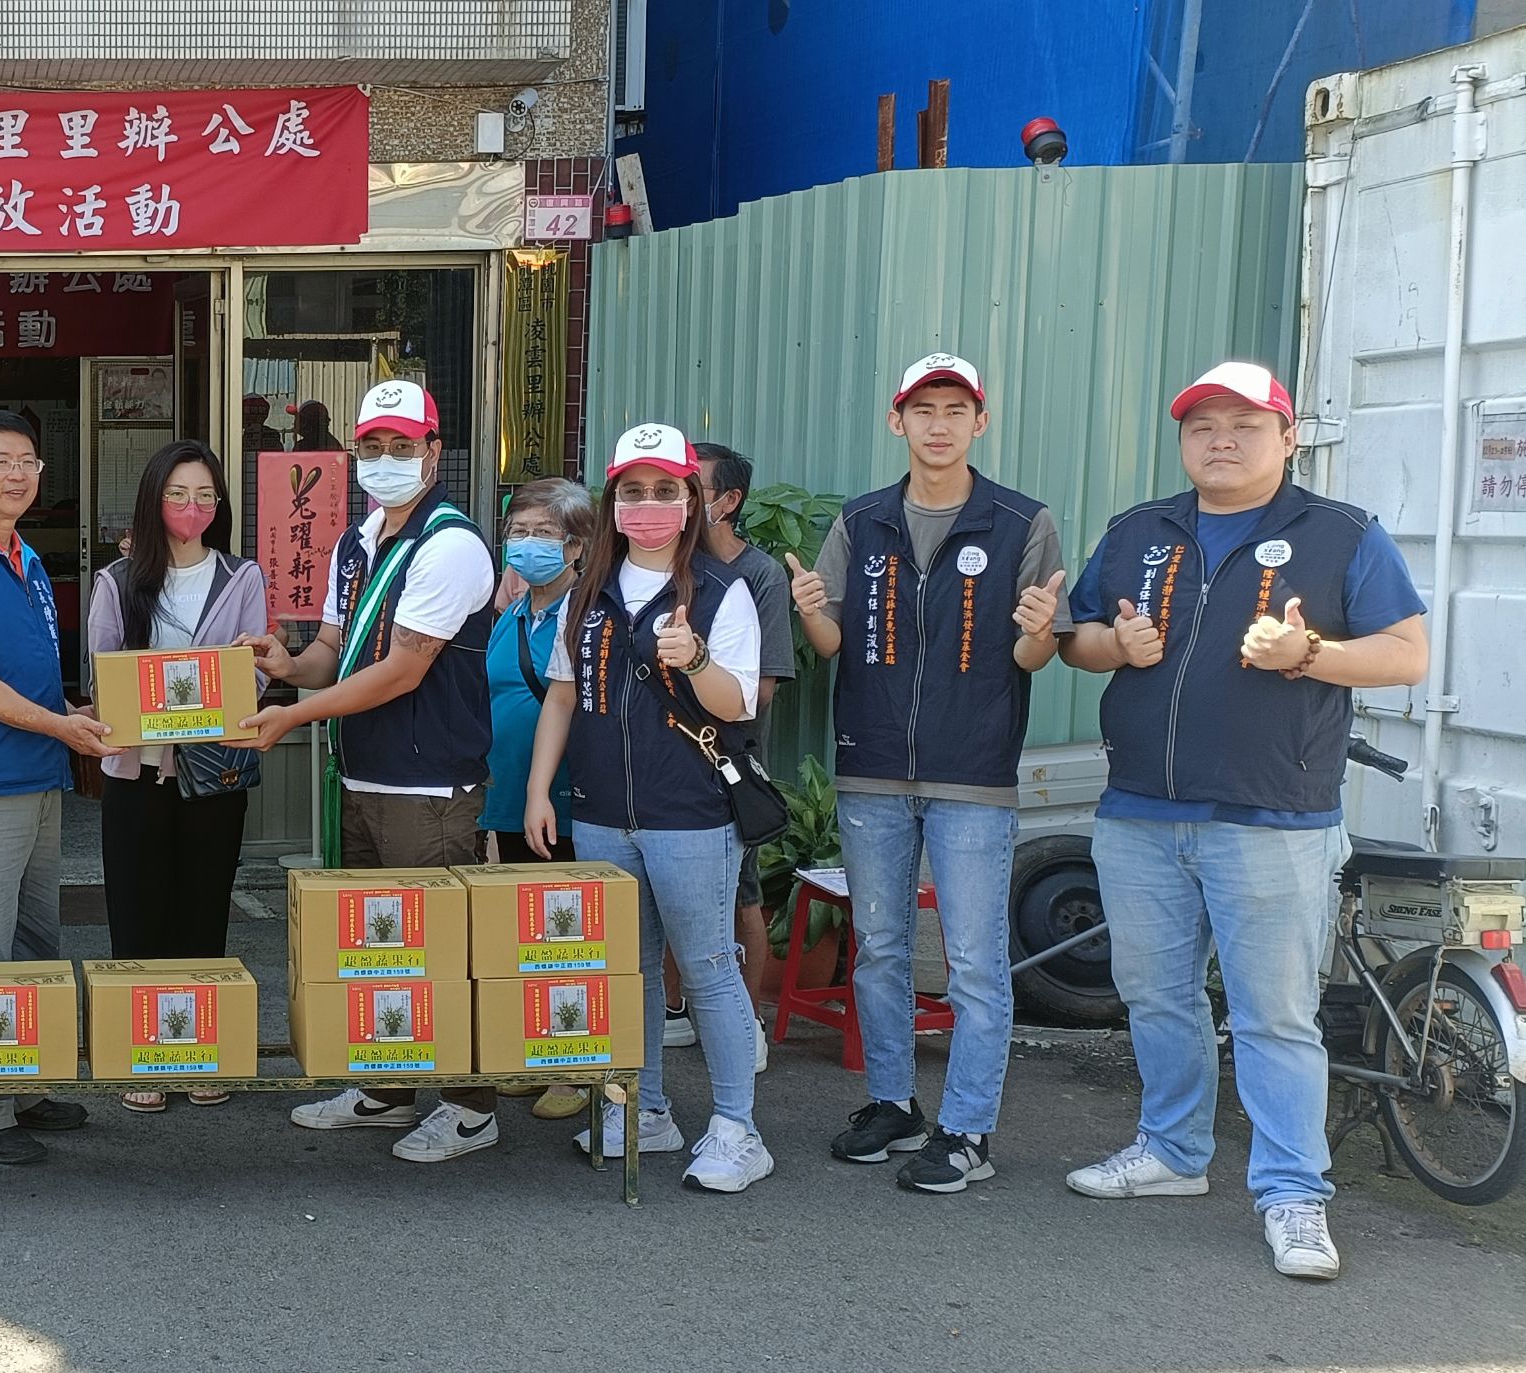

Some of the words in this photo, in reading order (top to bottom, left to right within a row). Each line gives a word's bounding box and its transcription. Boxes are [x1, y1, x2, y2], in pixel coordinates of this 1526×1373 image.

[546, 214, 578, 236] 42
[521, 317, 548, 478] 凌雲里辦公處
[288, 463, 323, 609] 兔躍新程
